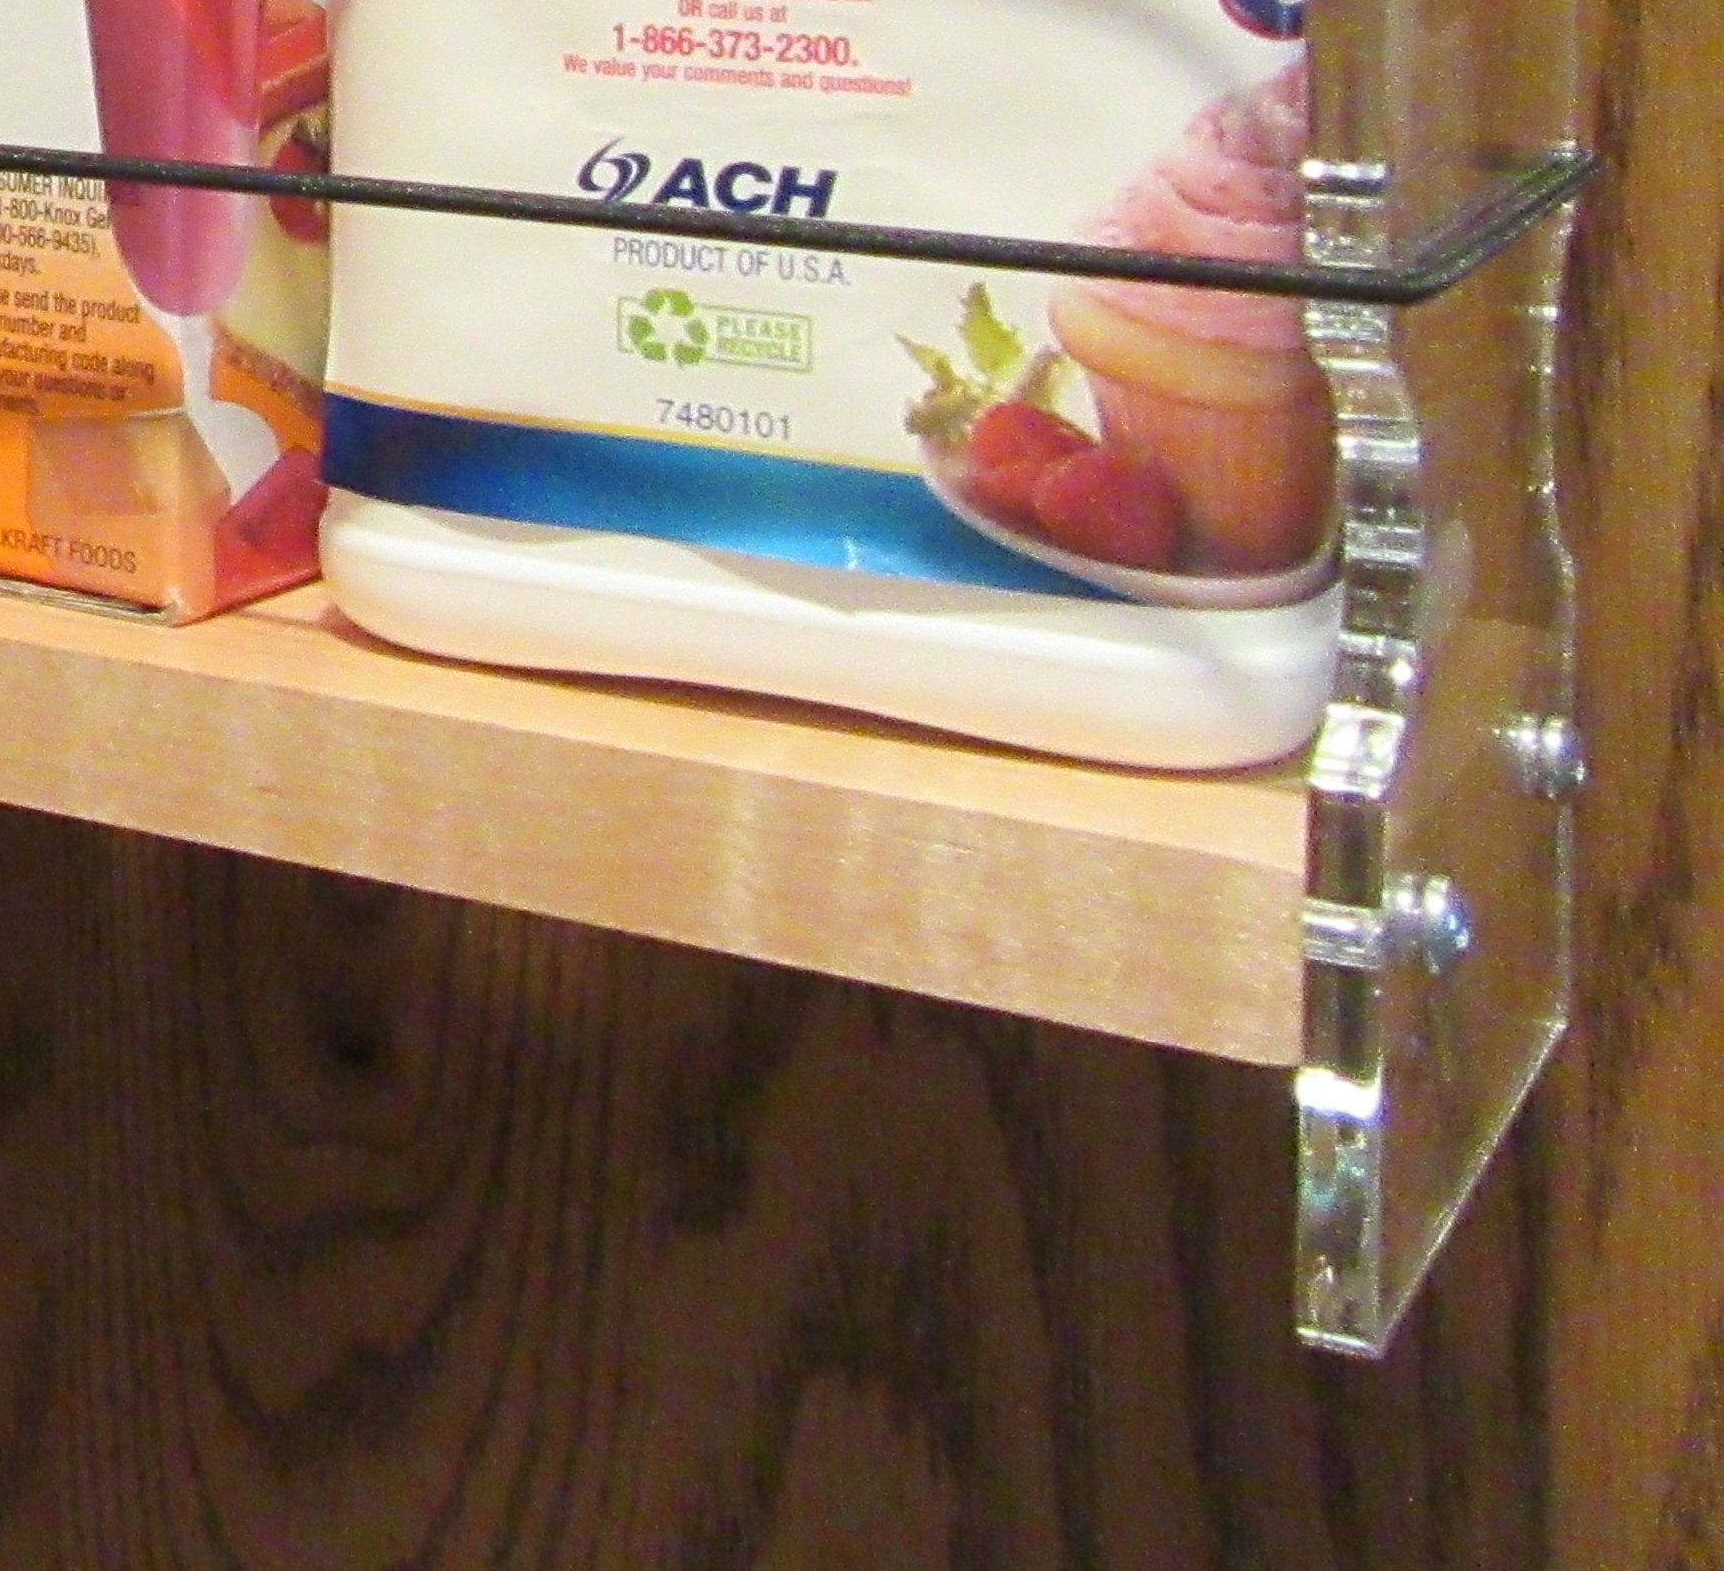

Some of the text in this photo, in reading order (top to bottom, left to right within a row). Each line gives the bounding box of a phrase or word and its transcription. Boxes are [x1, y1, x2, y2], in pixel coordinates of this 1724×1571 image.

[709, 0, 738, 20] call
[744, 4, 764, 23] us
[769, 5, 788, 24] at
[612, 21, 859, 68] 1-866-373-2300.
[562, 51, 913, 97] We value your comments and questions!
[654, 157, 840, 219] ACH
[613, 236, 851, 286] PRODUCT OF U.S.A.
[15, 288, 50, 313] send
[53, 292, 77, 315] the
[81, 298, 141, 325] product
[0, 313, 55, 339] number
[58, 322, 87, 343] and
[716, 314, 803, 342] PLEASE
[718, 335, 803, 363] RECYCLE
[33, 372, 105, 400] questions
[109, 382, 127, 400] or
[71, 351, 109, 371] code
[113, 354, 155, 385] along
[656, 398, 793, 440] 7480101
[0, 525, 138, 575] KRAFT FOODS
